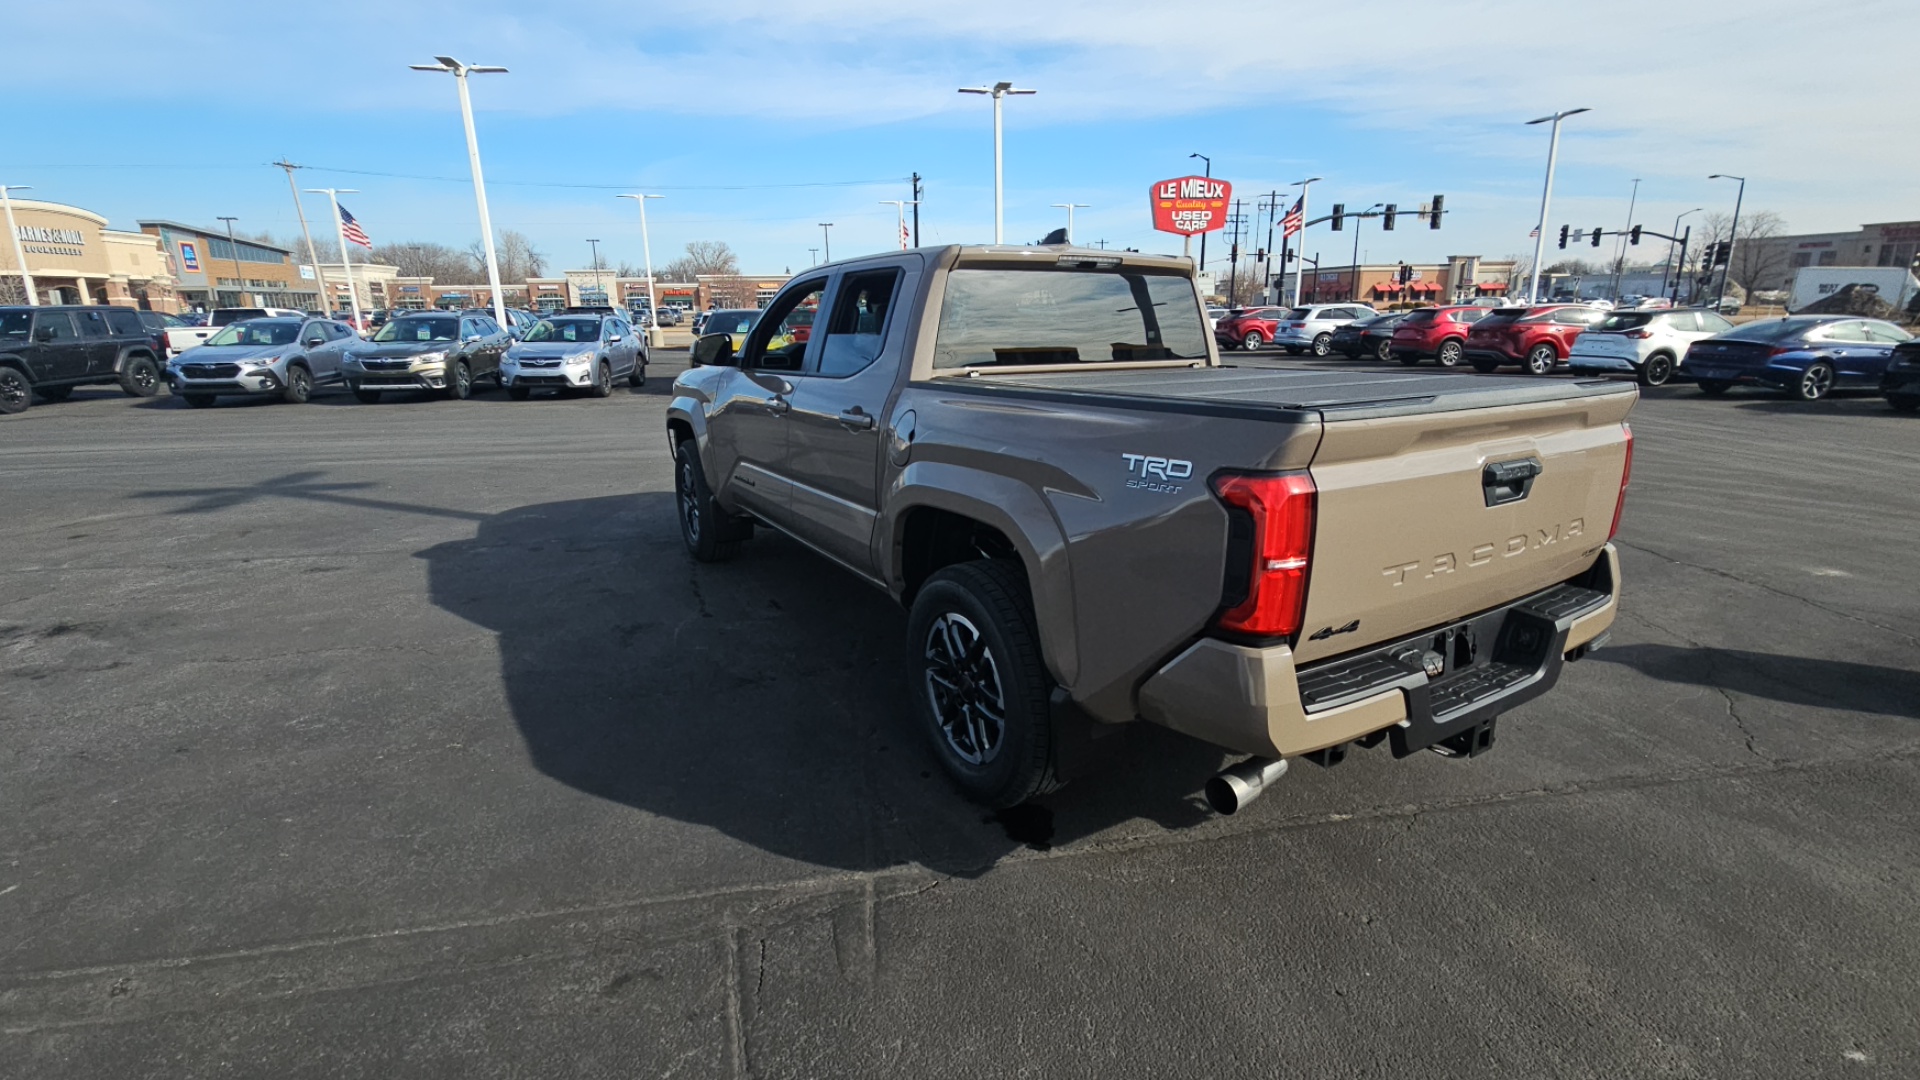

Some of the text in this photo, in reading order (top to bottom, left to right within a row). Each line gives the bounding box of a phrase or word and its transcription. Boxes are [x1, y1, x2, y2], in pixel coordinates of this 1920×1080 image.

[1159, 179, 1224, 199] LE MIEUX
[1175, 200, 1206, 210] Quality
[1171, 210, 1212, 221] USED
[1175, 220, 1208, 232] CARS
[1122, 453, 1193, 481] TRD
[1126, 480, 1182, 494] SPORT
[1382, 517, 1585, 587] TACOMA
